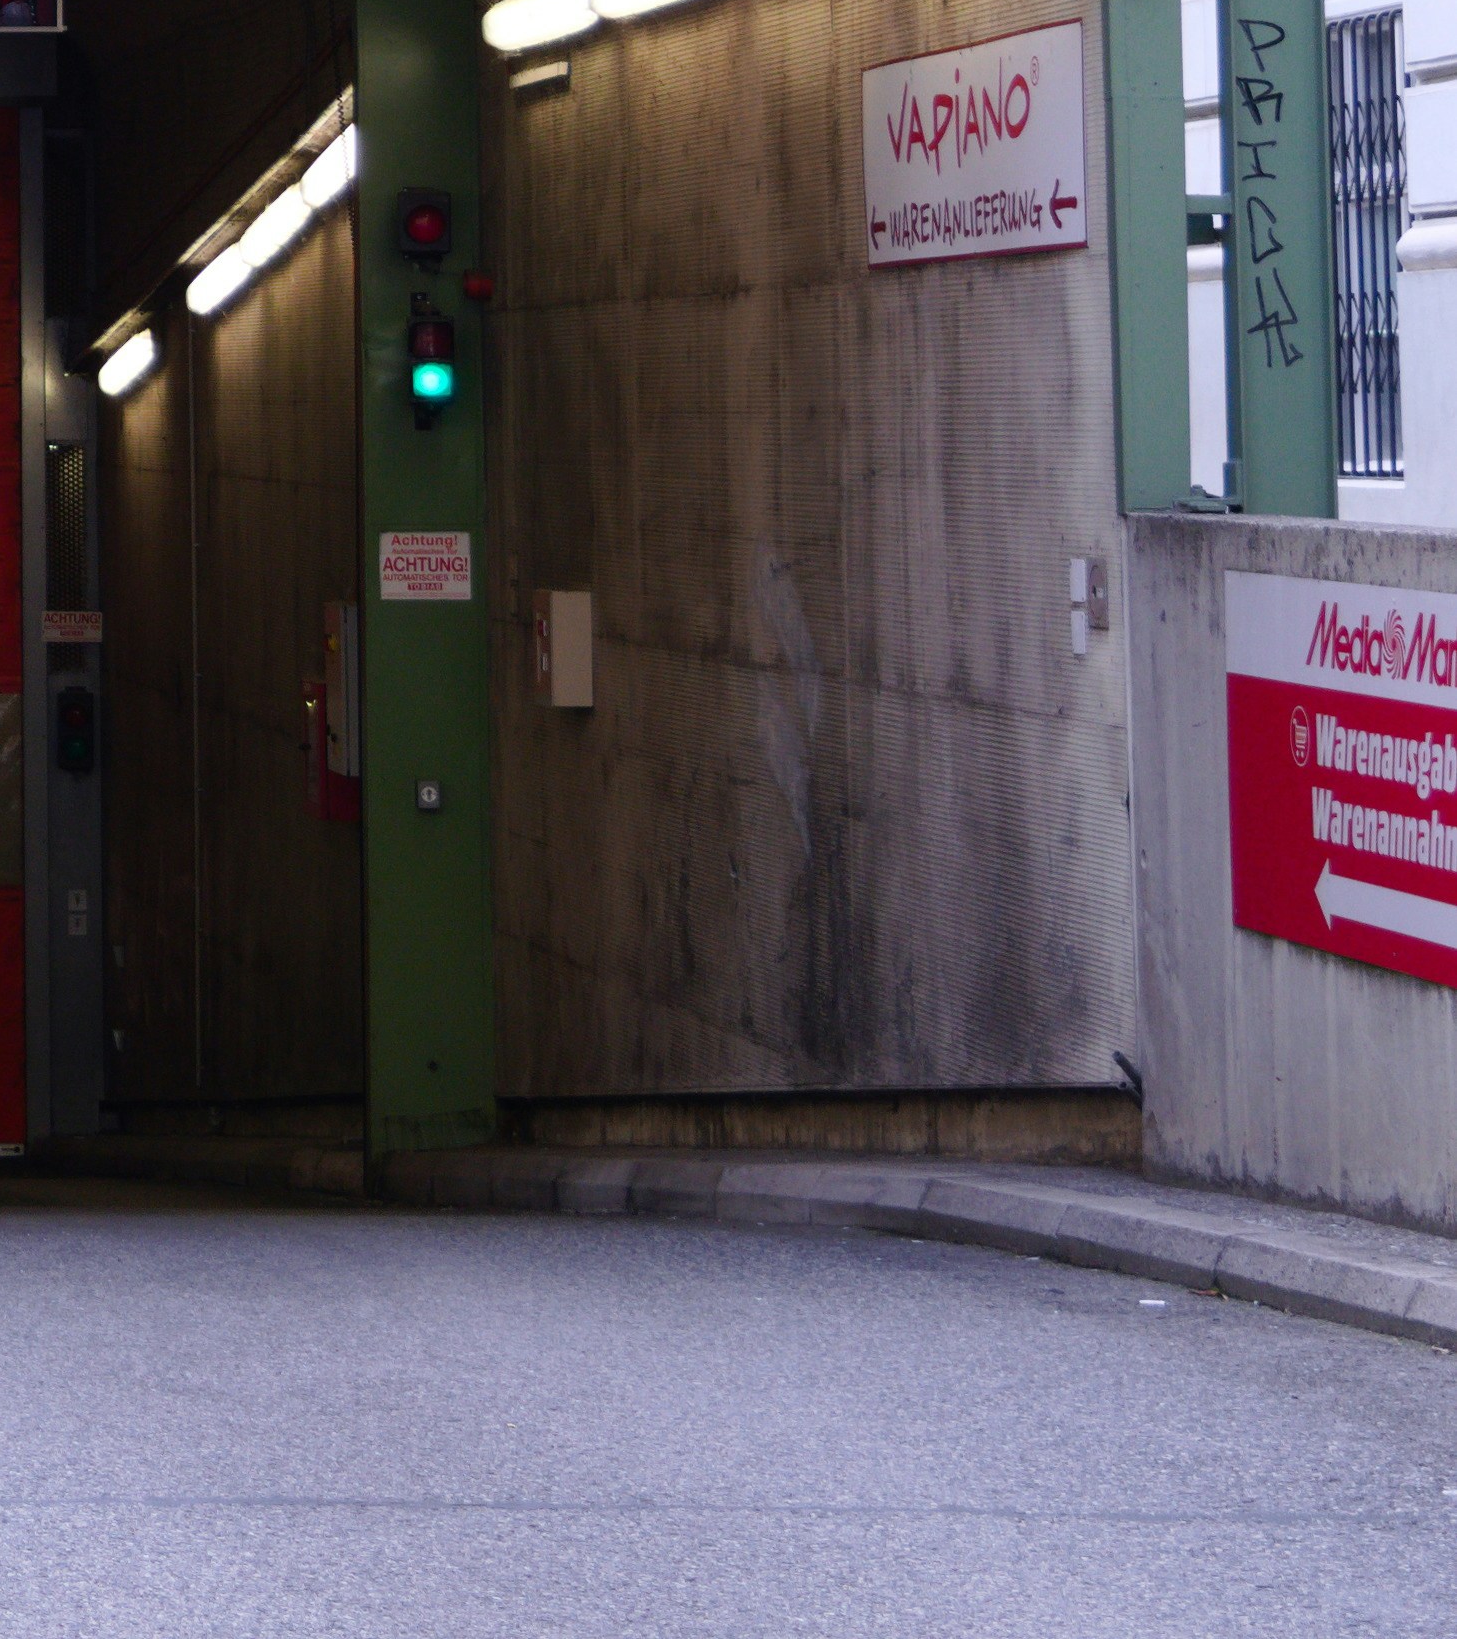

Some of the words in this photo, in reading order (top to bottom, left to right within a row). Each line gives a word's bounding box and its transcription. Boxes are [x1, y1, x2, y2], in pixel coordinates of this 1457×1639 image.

[888, 188, 1044, 250] WARENANLIEFERUNG
[391, 534, 458, 548] Achtung!
[383, 556, 468, 572] ACHTUNG!
